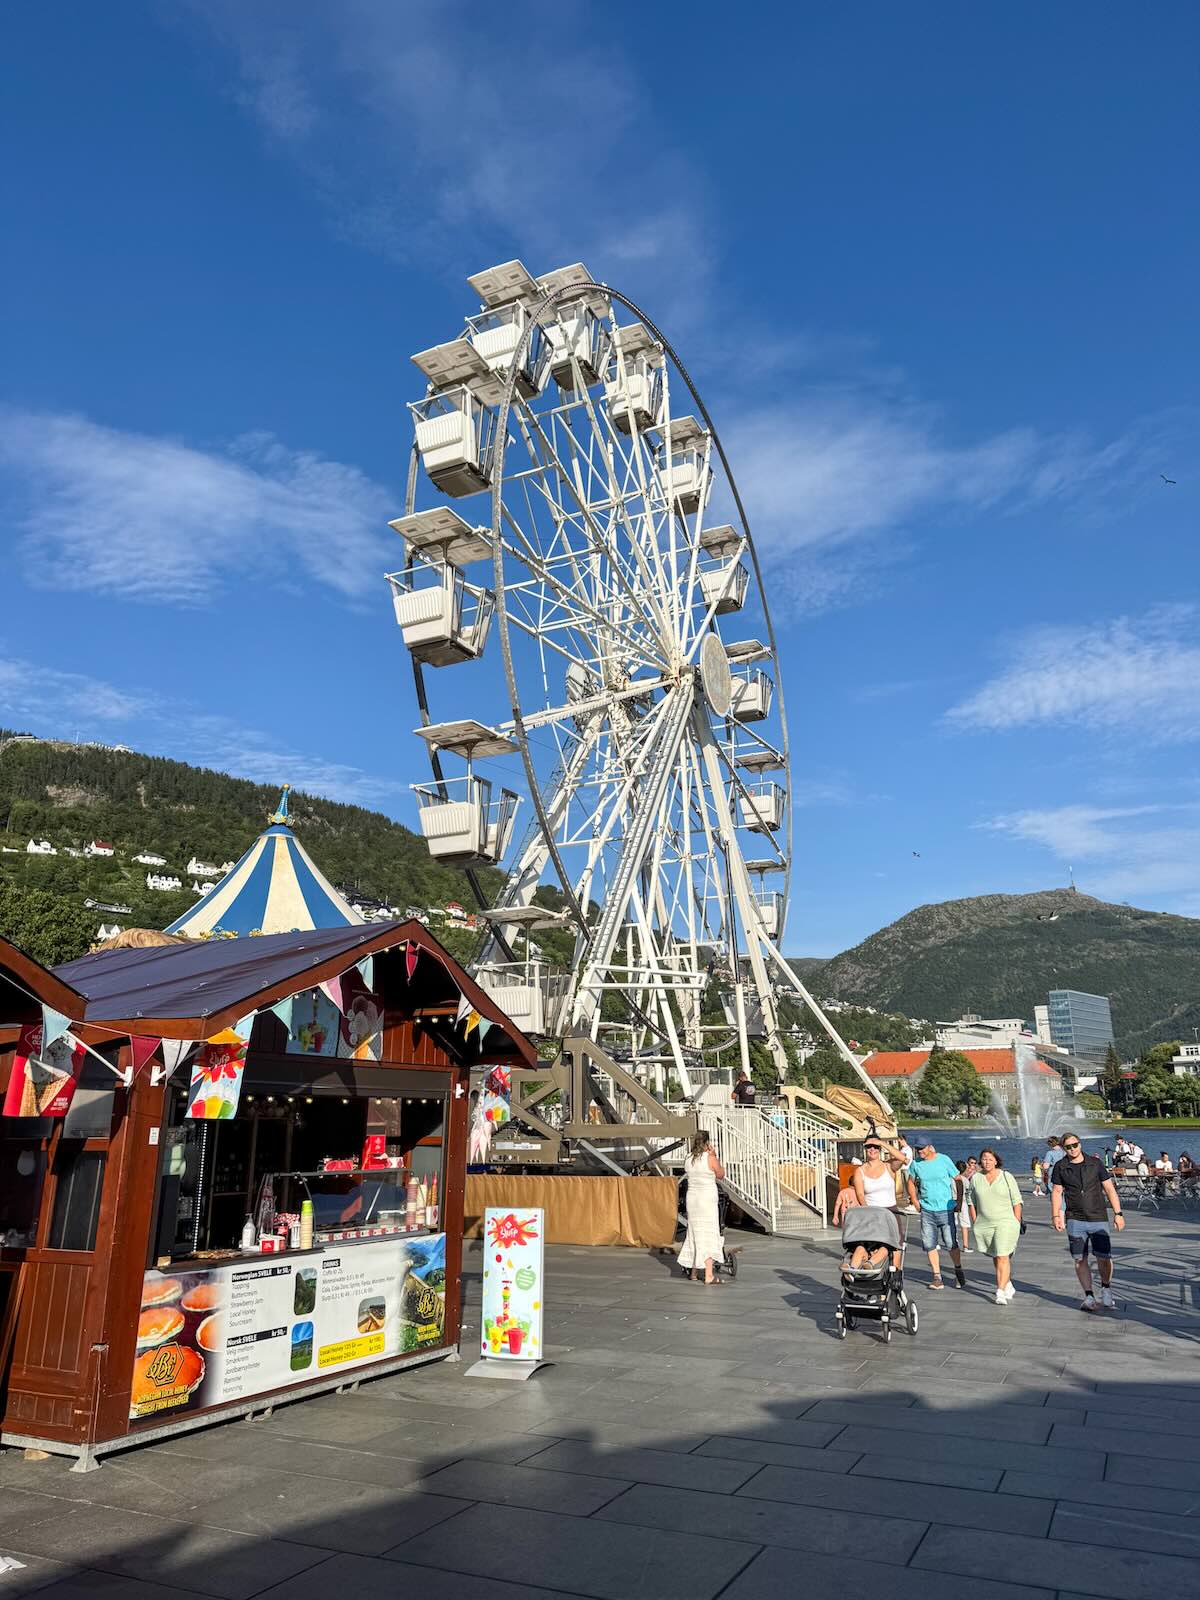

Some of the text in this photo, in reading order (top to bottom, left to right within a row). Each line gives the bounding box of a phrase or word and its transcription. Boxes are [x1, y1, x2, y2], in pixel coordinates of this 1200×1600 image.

[323, 1260, 339, 1268] DRINKS
[232, 1272, 258, 1281] Norwegian
[258, 1269, 272, 1277] SVELE
[232, 1282, 250, 1290] Topping
[232, 1290, 258, 1299] Buttercream
[231, 1300, 254, 1308] Strawberry
[230, 1308, 256, 1318] Local Honey
[227, 1336, 242, 1346] Norsk
[242, 1334, 257, 1343] SVELE
[226, 1347, 236, 1355] Velg
